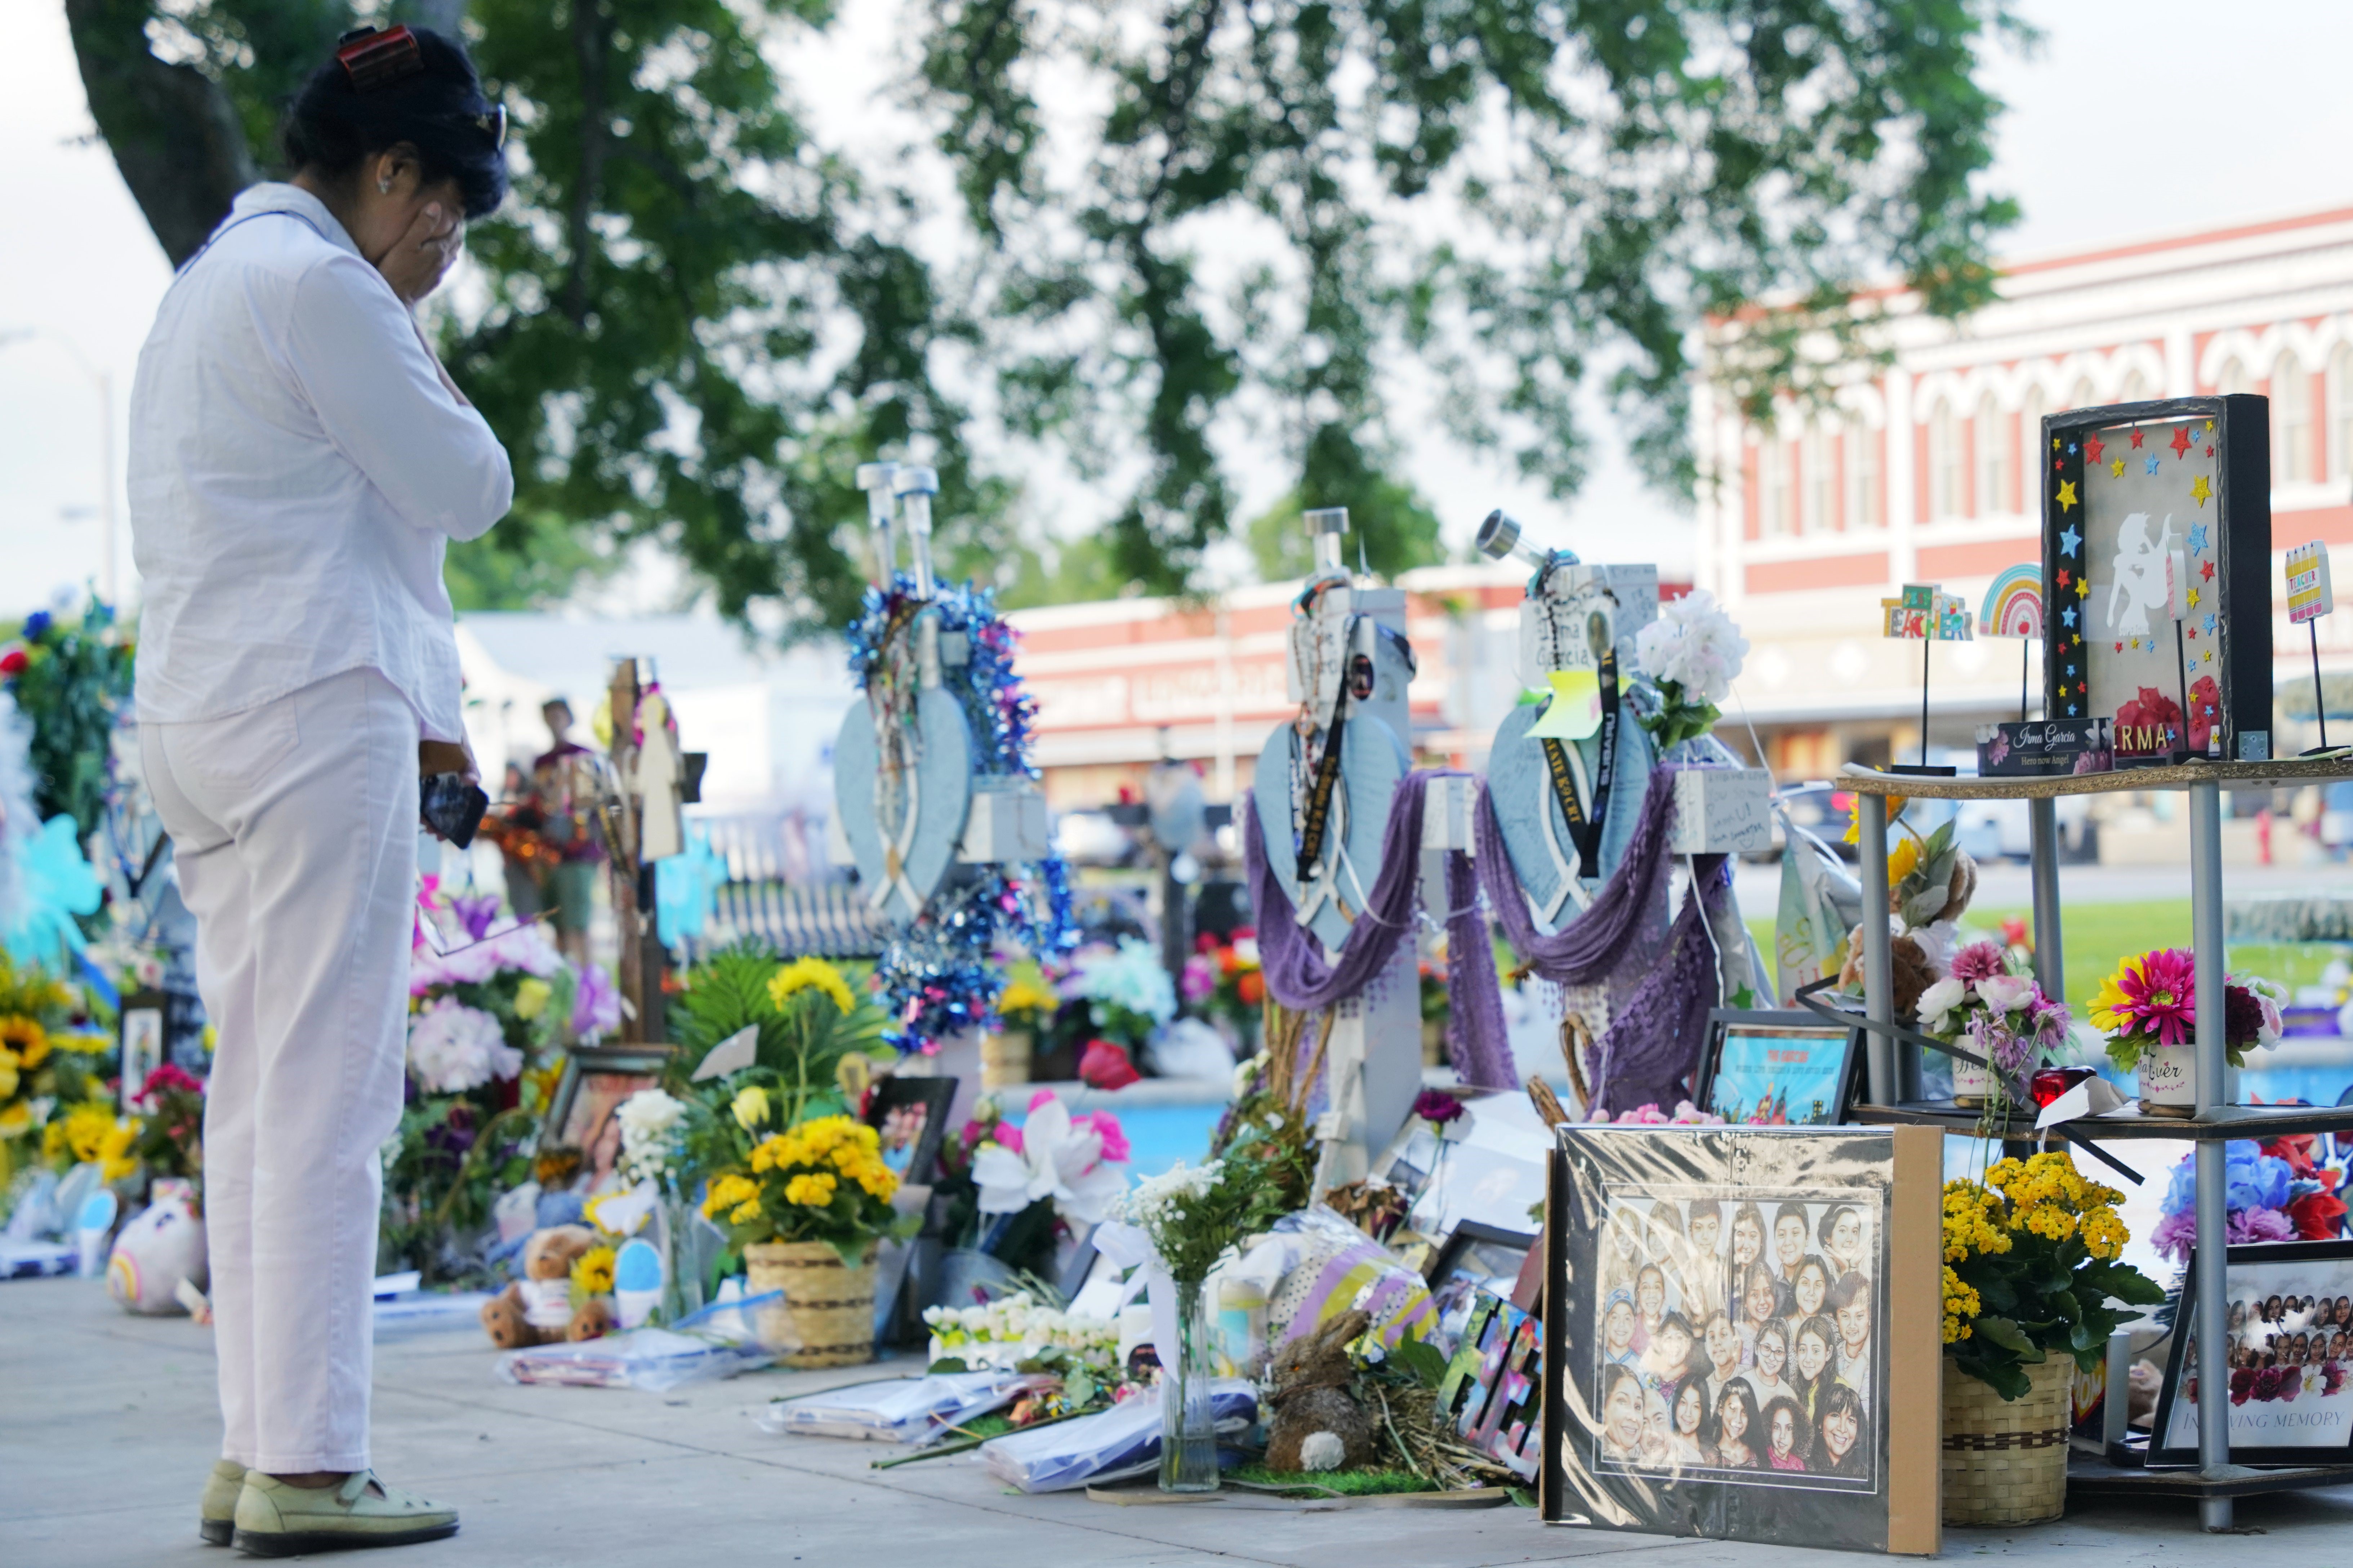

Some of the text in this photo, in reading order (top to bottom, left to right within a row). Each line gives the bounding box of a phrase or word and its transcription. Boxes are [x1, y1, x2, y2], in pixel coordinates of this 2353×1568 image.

[2290, 571, 2316, 590] TEACHER
[1599, 712, 1616, 786] SUBARU
[2013, 723, 2076, 752] Irma Garcia
[2021, 757, 2036, 766] Hero
[2052, 754, 2069, 766] Angel
[2149, 1052, 2183, 1081] Ever
[2229, 1415, 2268, 1429] VING
[2274, 1411, 2344, 1428] MEMORY
